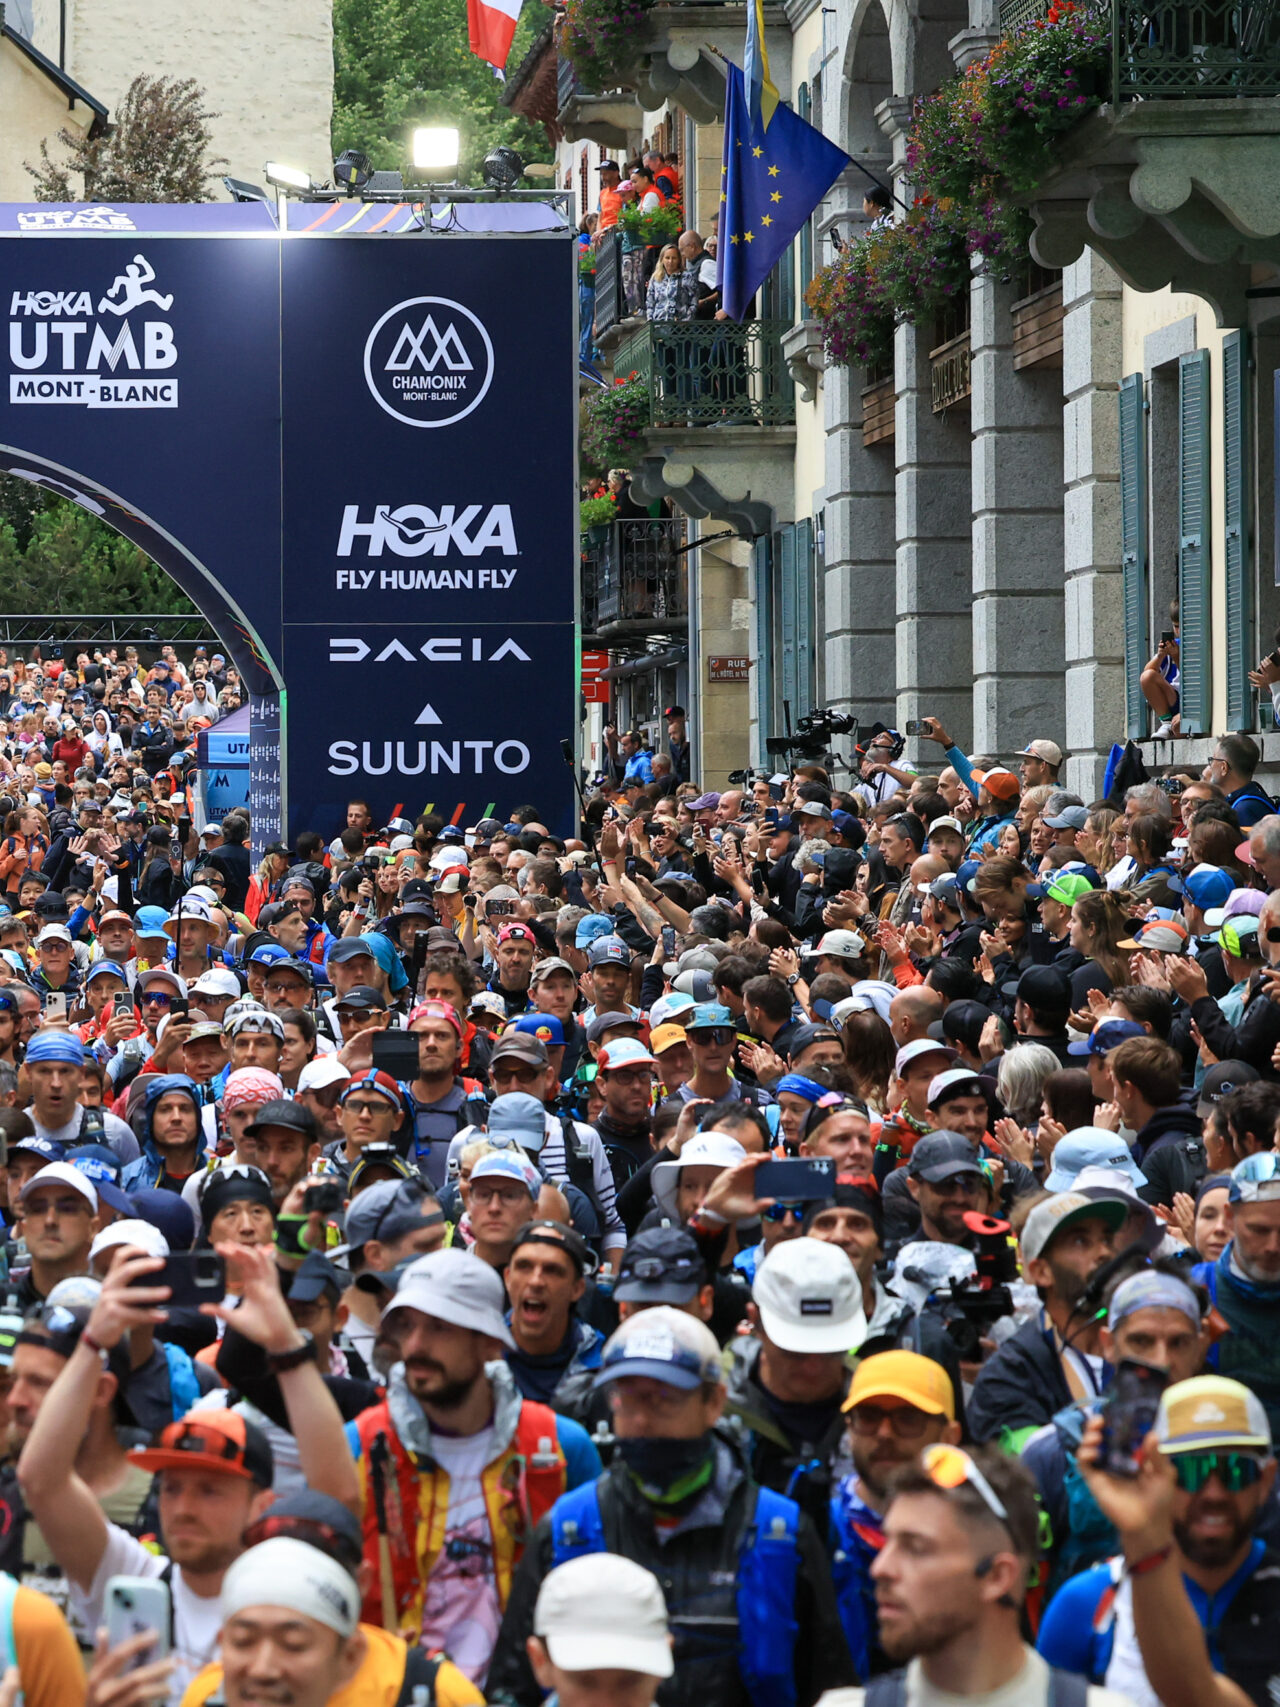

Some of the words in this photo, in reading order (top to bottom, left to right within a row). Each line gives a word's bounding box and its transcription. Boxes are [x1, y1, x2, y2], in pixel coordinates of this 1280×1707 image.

[10, 291, 94, 316] HOKA
[10, 318, 178, 373] UTMB
[17, 381, 172, 402] MONT-BLANC
[392, 375, 467, 389] CHAMONIX
[403, 392, 458, 400] MONT-BLANC
[336, 504, 518, 558] HOKA
[336, 570, 375, 589] FLY
[380, 570, 473, 589] HUMAN
[478, 569, 517, 589] FLY
[329, 638, 532, 661] DACIA
[728, 659, 746, 668] RUE
[328, 740, 531, 776] SUUNTO
